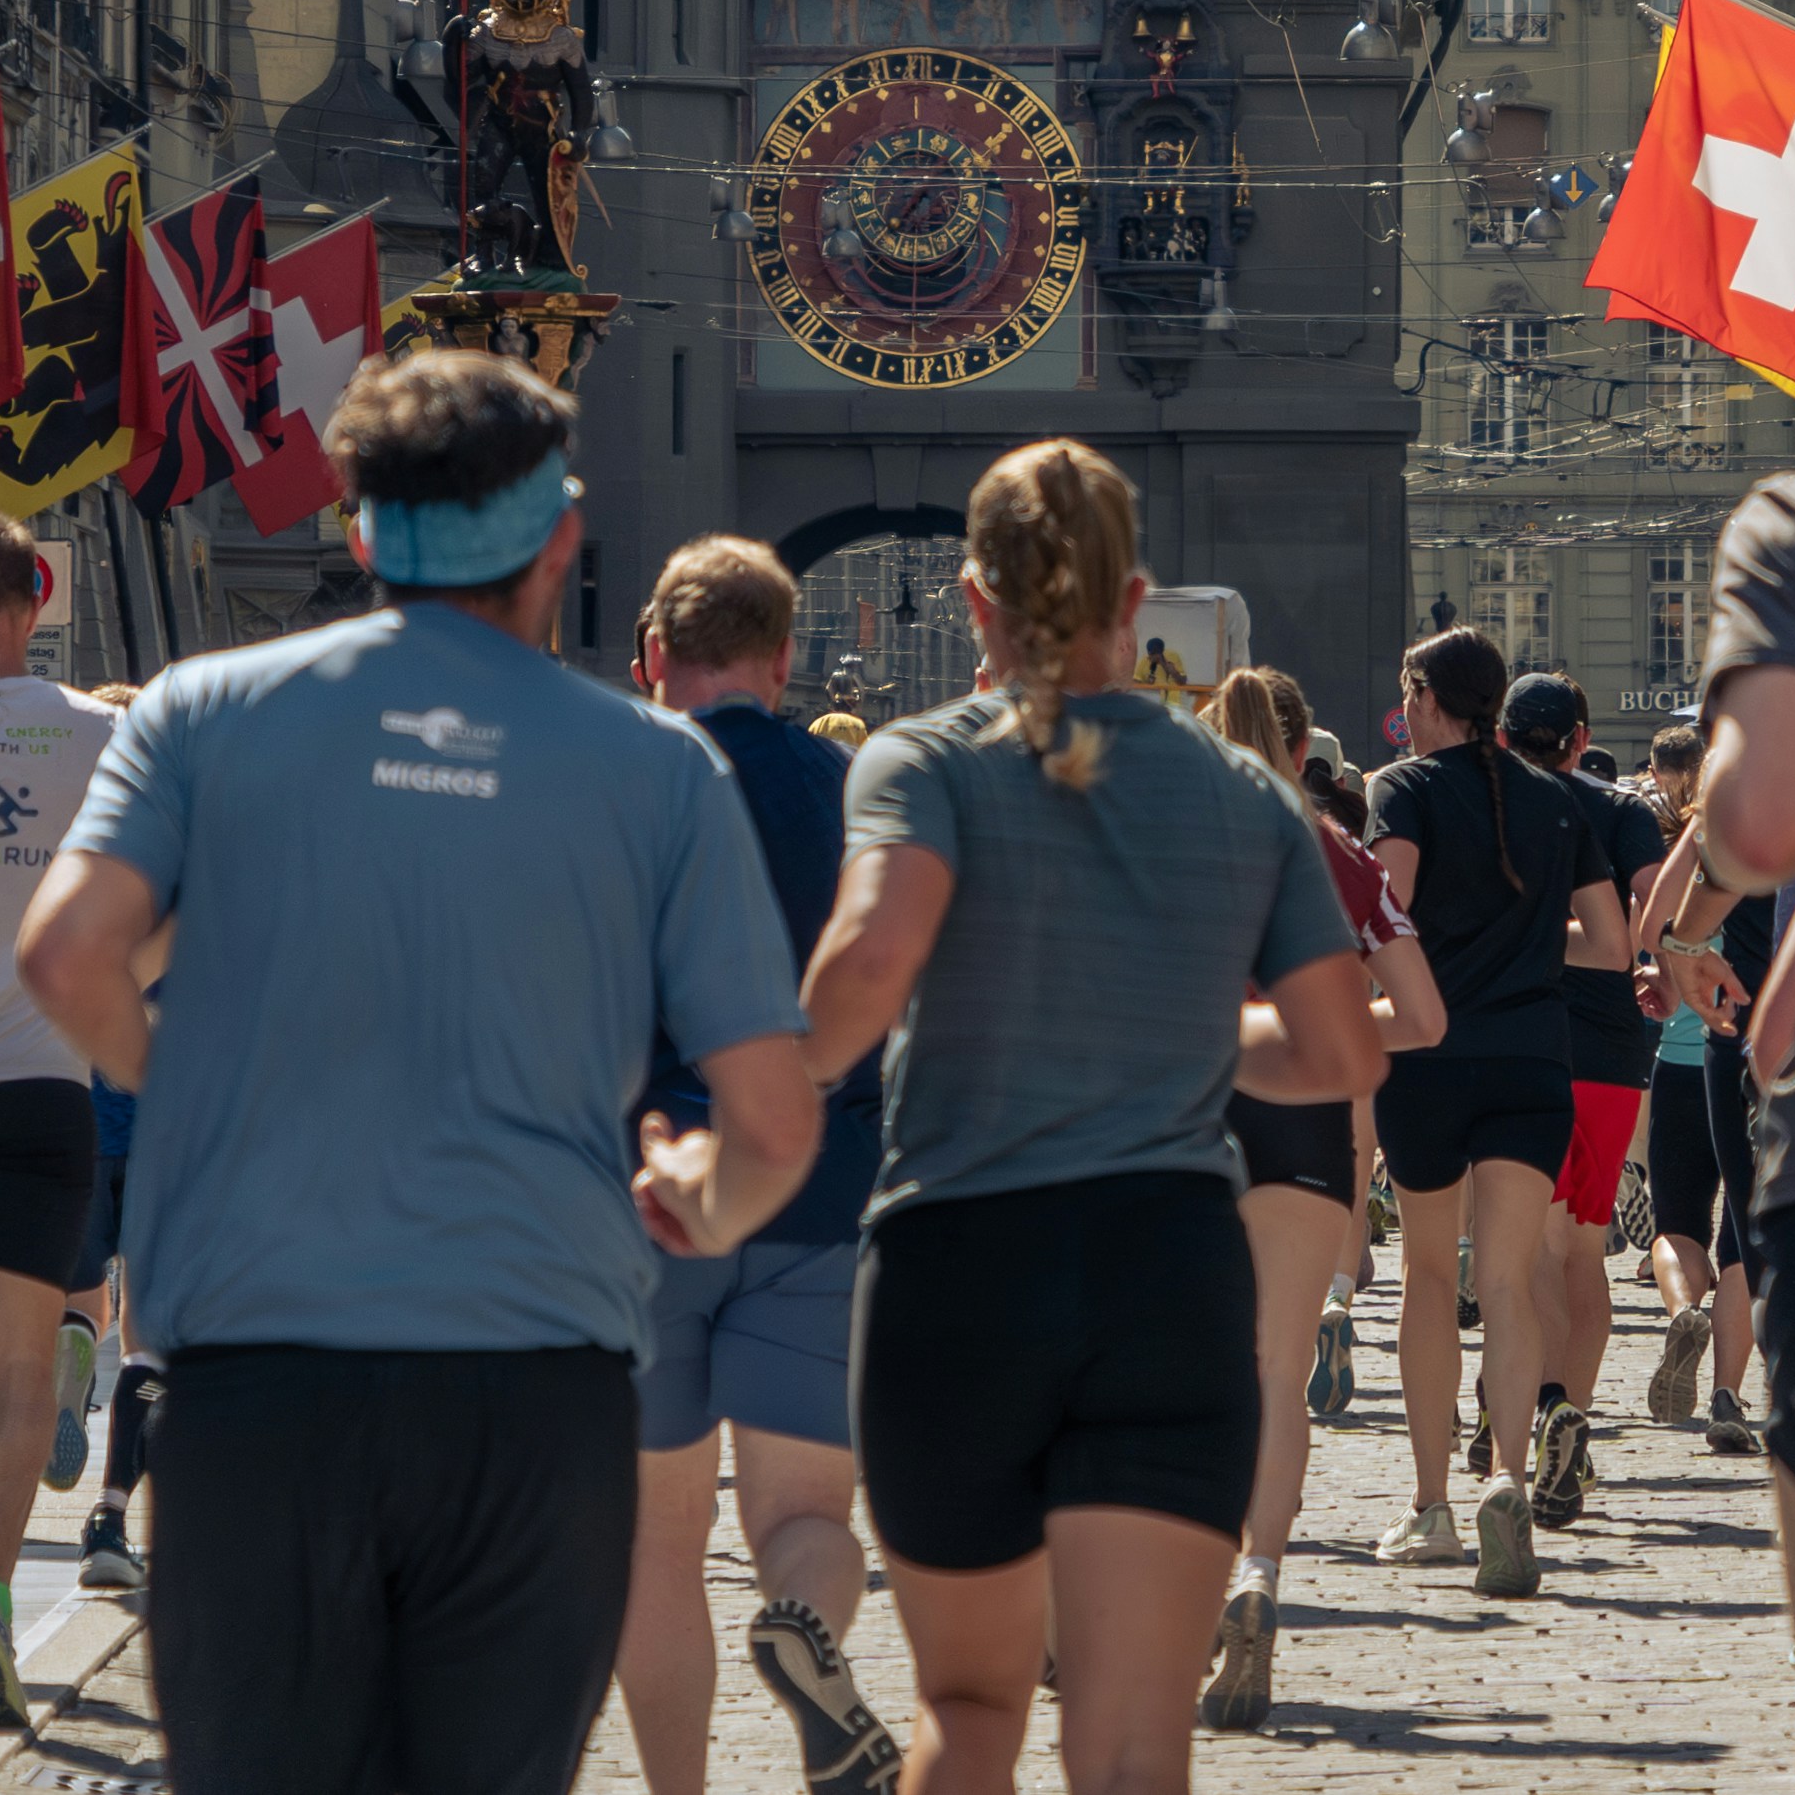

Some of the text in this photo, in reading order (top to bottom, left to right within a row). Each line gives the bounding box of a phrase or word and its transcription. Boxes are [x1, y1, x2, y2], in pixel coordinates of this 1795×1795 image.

[30, 629, 60, 640] asse
[28, 647, 55, 659] stag
[31, 664, 48, 676] 25
[6, 726, 74, 739] ENERGY
[28, 743, 51, 755] US
[372, 758, 500, 799] MIGROS
